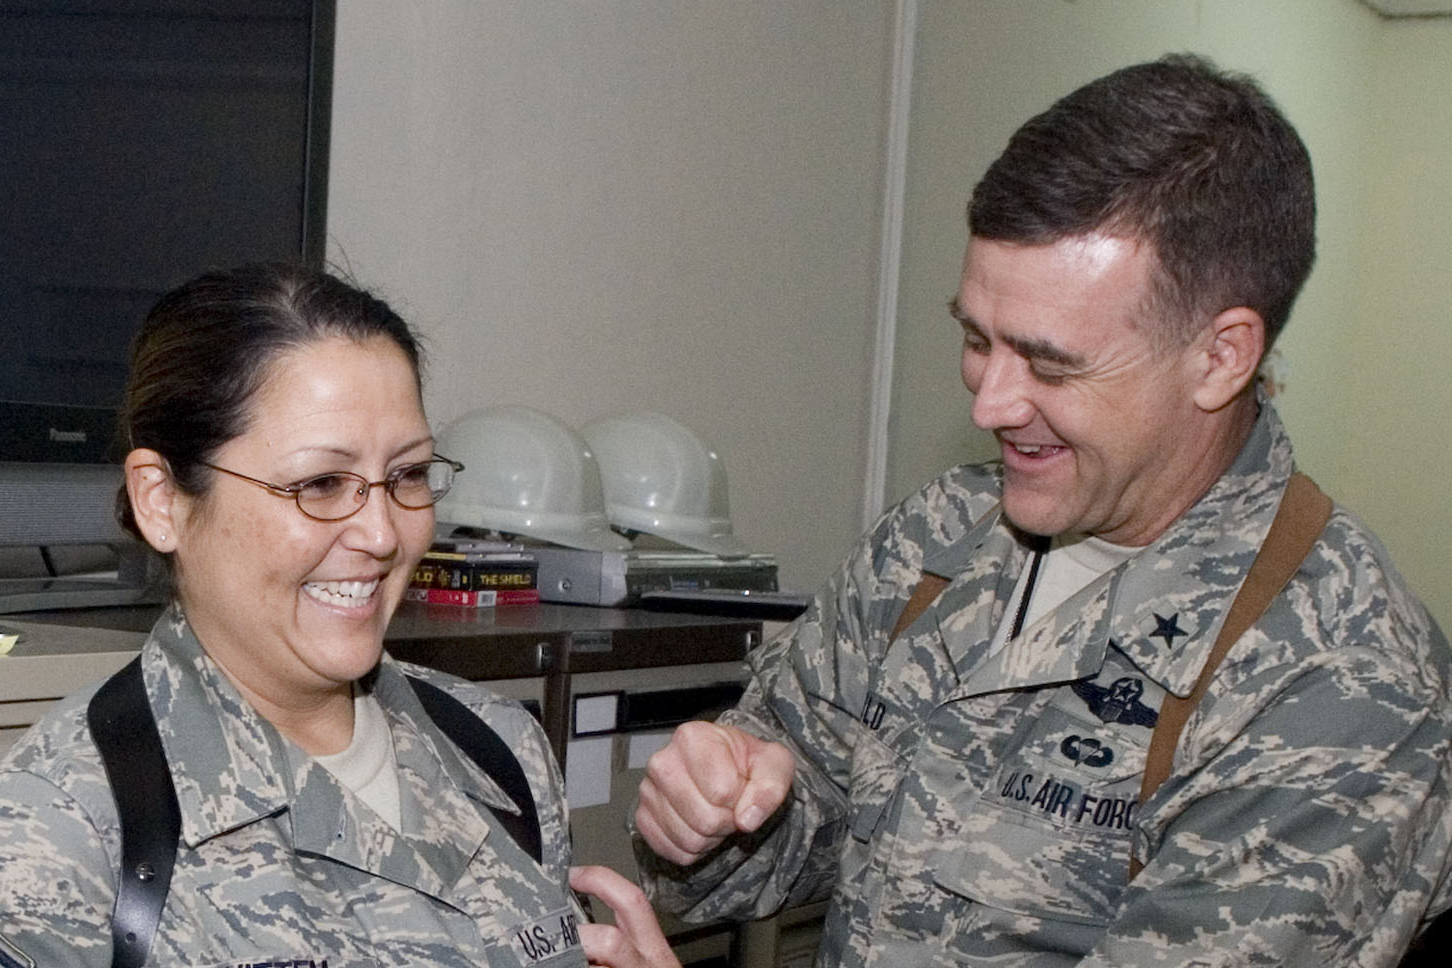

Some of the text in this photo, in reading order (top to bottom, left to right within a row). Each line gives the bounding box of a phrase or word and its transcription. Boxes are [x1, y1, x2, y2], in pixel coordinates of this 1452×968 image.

[1001, 772, 1033, 803] U.S.
[1031, 779, 1073, 818] AIR
[517, 925, 557, 960] U.S.
